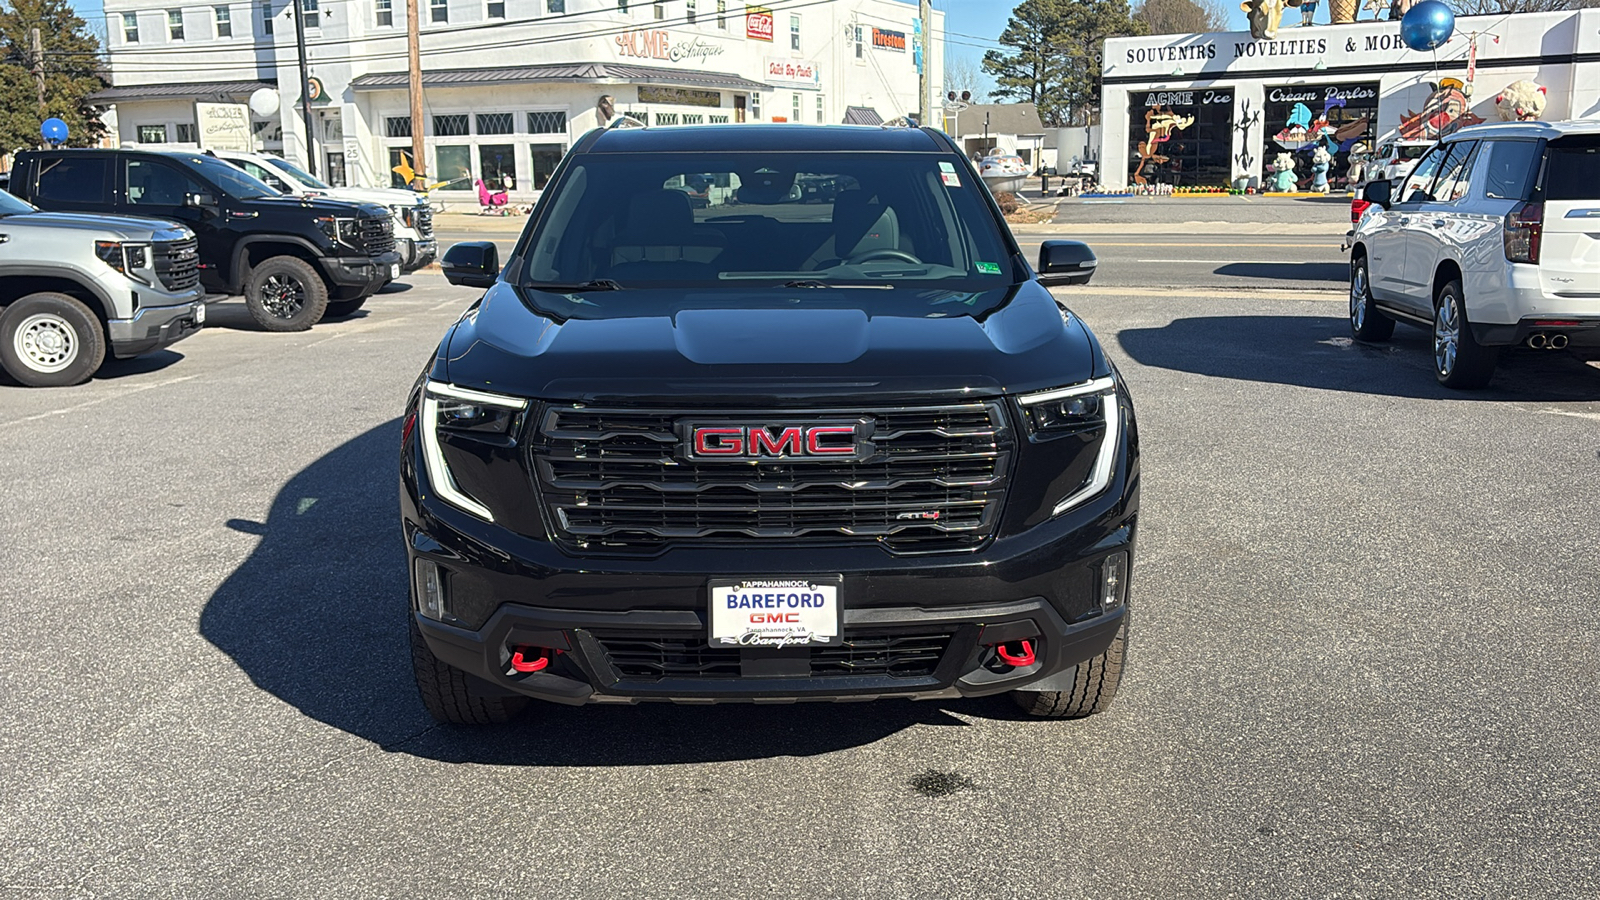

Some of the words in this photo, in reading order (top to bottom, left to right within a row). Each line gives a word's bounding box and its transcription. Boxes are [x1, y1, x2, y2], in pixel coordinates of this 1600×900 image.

[615, 29, 670, 61] ACME
[872, 27, 905, 49] Firestone
[1126, 44, 1216, 64] SOUVENIRS
[1234, 38, 1327, 58] NOVELTIES
[1345, 36, 1357, 53] &
[1364, 33, 1411, 51] MOR
[1145, 91, 1194, 106] ACME
[1202, 90, 1232, 105] Ice
[1269, 88, 1318, 103] Cream
[1324, 86, 1376, 100] Parlor
[347, 149, 359, 159] 25
[694, 426, 857, 457] GMC
[741, 580, 809, 588] TAPPAHANNOCK
[726, 593, 825, 610] BAREFORD
[750, 612, 800, 624] GMC
[738, 631, 813, 650] Bareford
